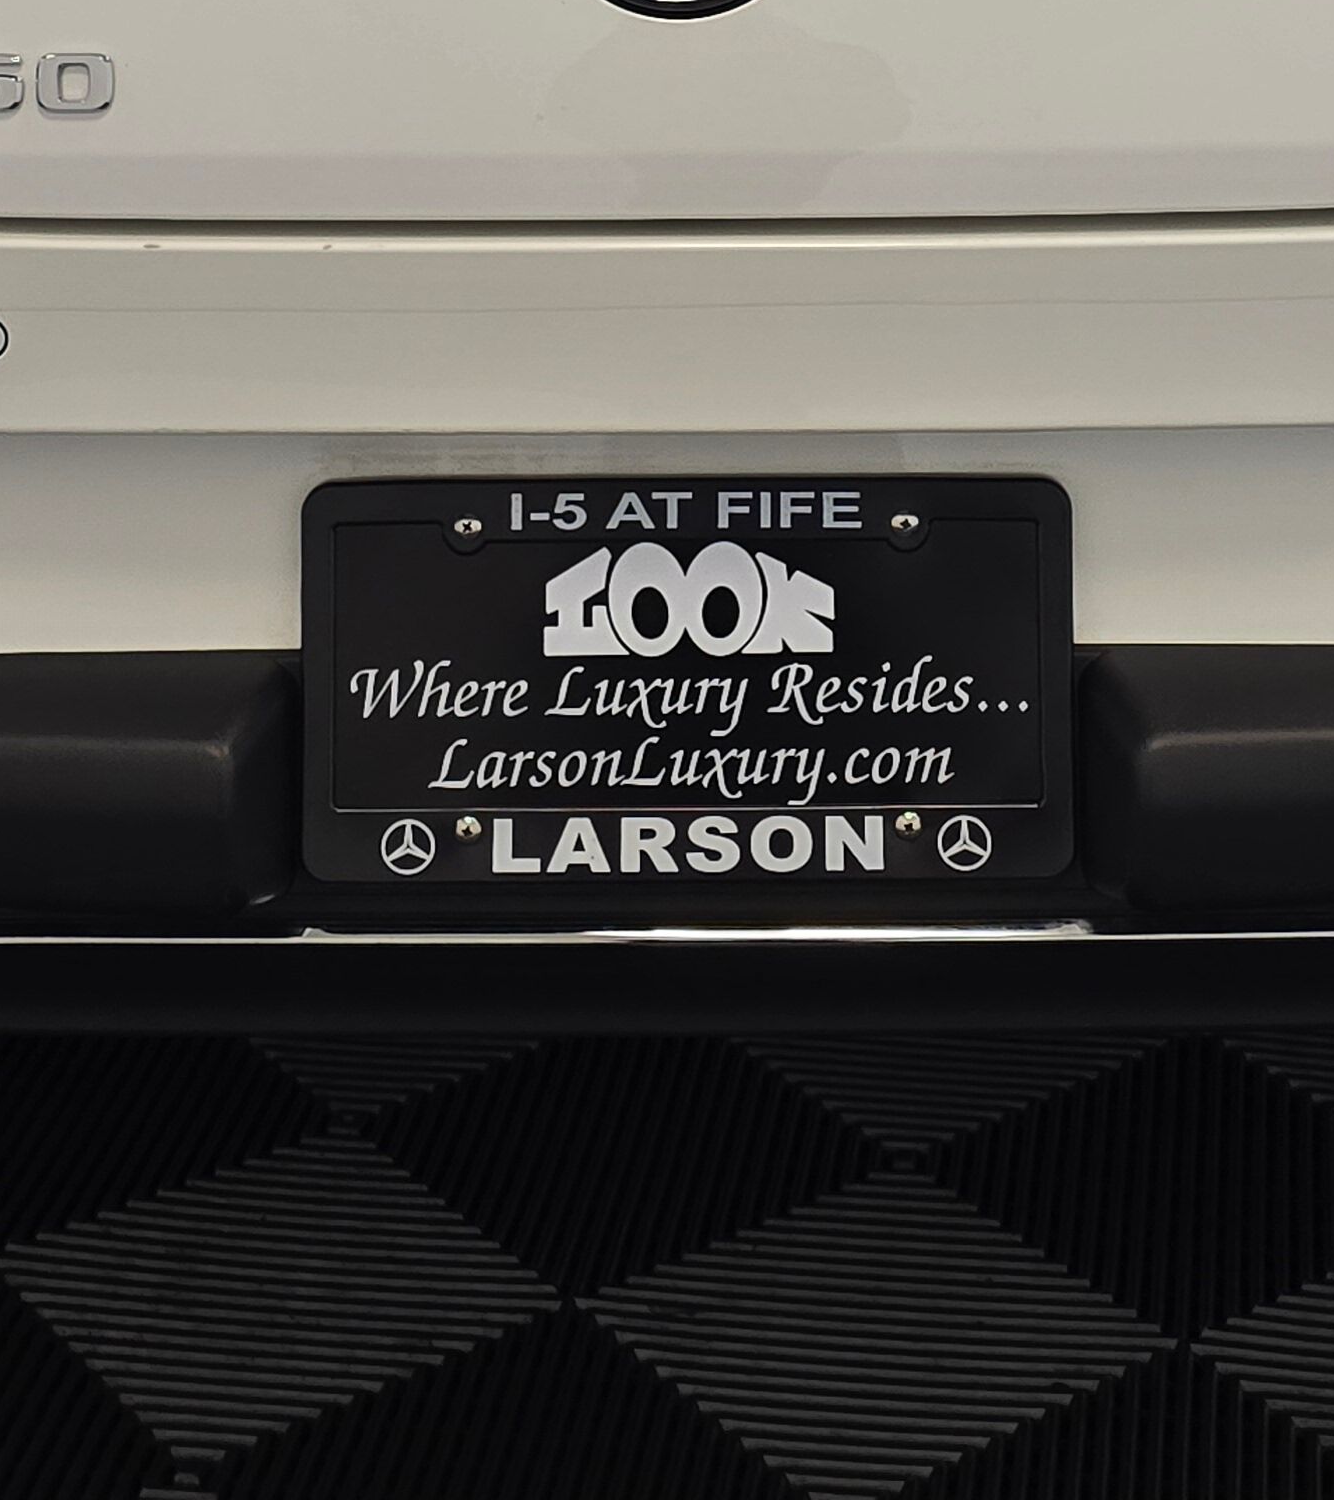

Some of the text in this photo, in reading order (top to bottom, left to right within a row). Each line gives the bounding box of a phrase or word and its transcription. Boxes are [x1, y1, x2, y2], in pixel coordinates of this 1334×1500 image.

[510, 491, 862, 531] I-5 AT FIFE
[350, 655, 1029, 737] Where Luxury Resides...
[428, 736, 954, 806] LarsonLuxury.com
[491, 815, 885, 874] LARSON
